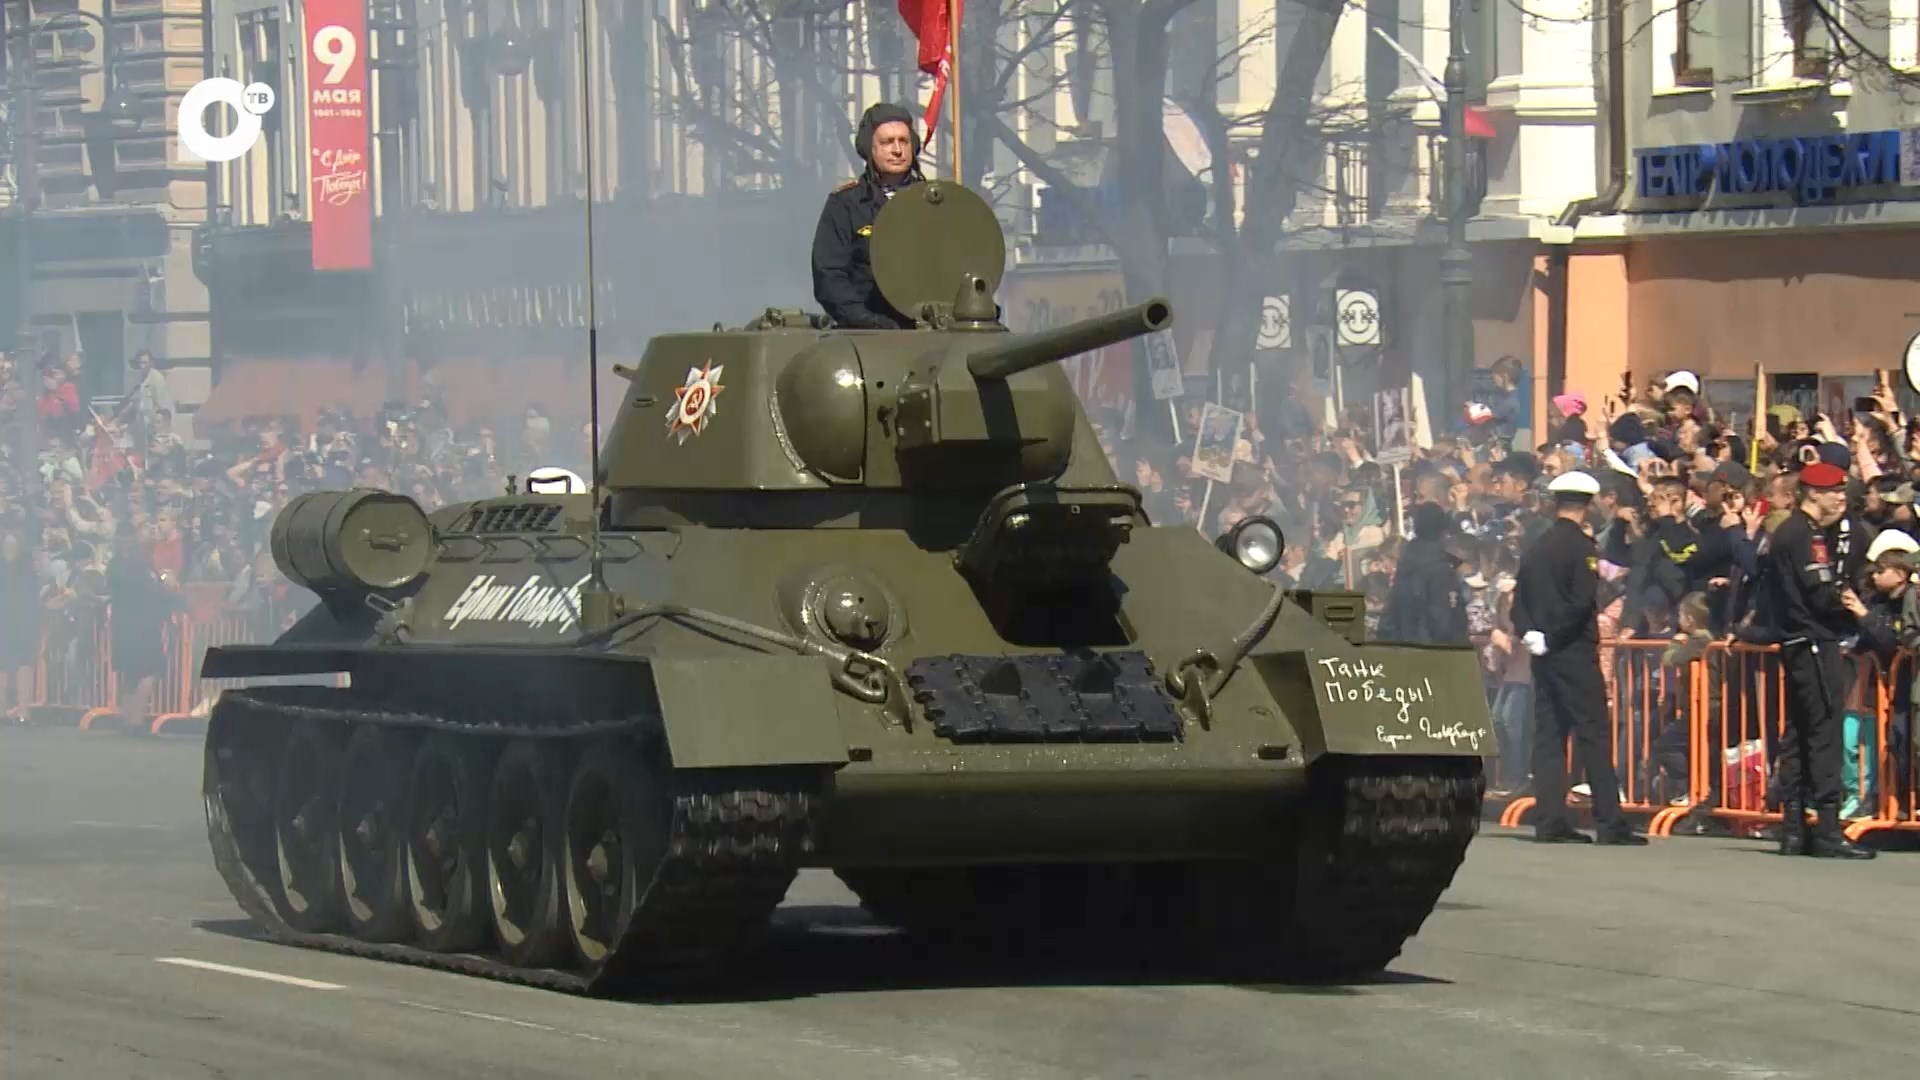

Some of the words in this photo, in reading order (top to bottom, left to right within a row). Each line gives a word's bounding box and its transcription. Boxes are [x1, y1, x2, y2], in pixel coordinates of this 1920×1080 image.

[313, 25, 357, 84] 9
[1318, 657, 1386, 678] Танк
[1325, 677, 1433, 724] Победы!
